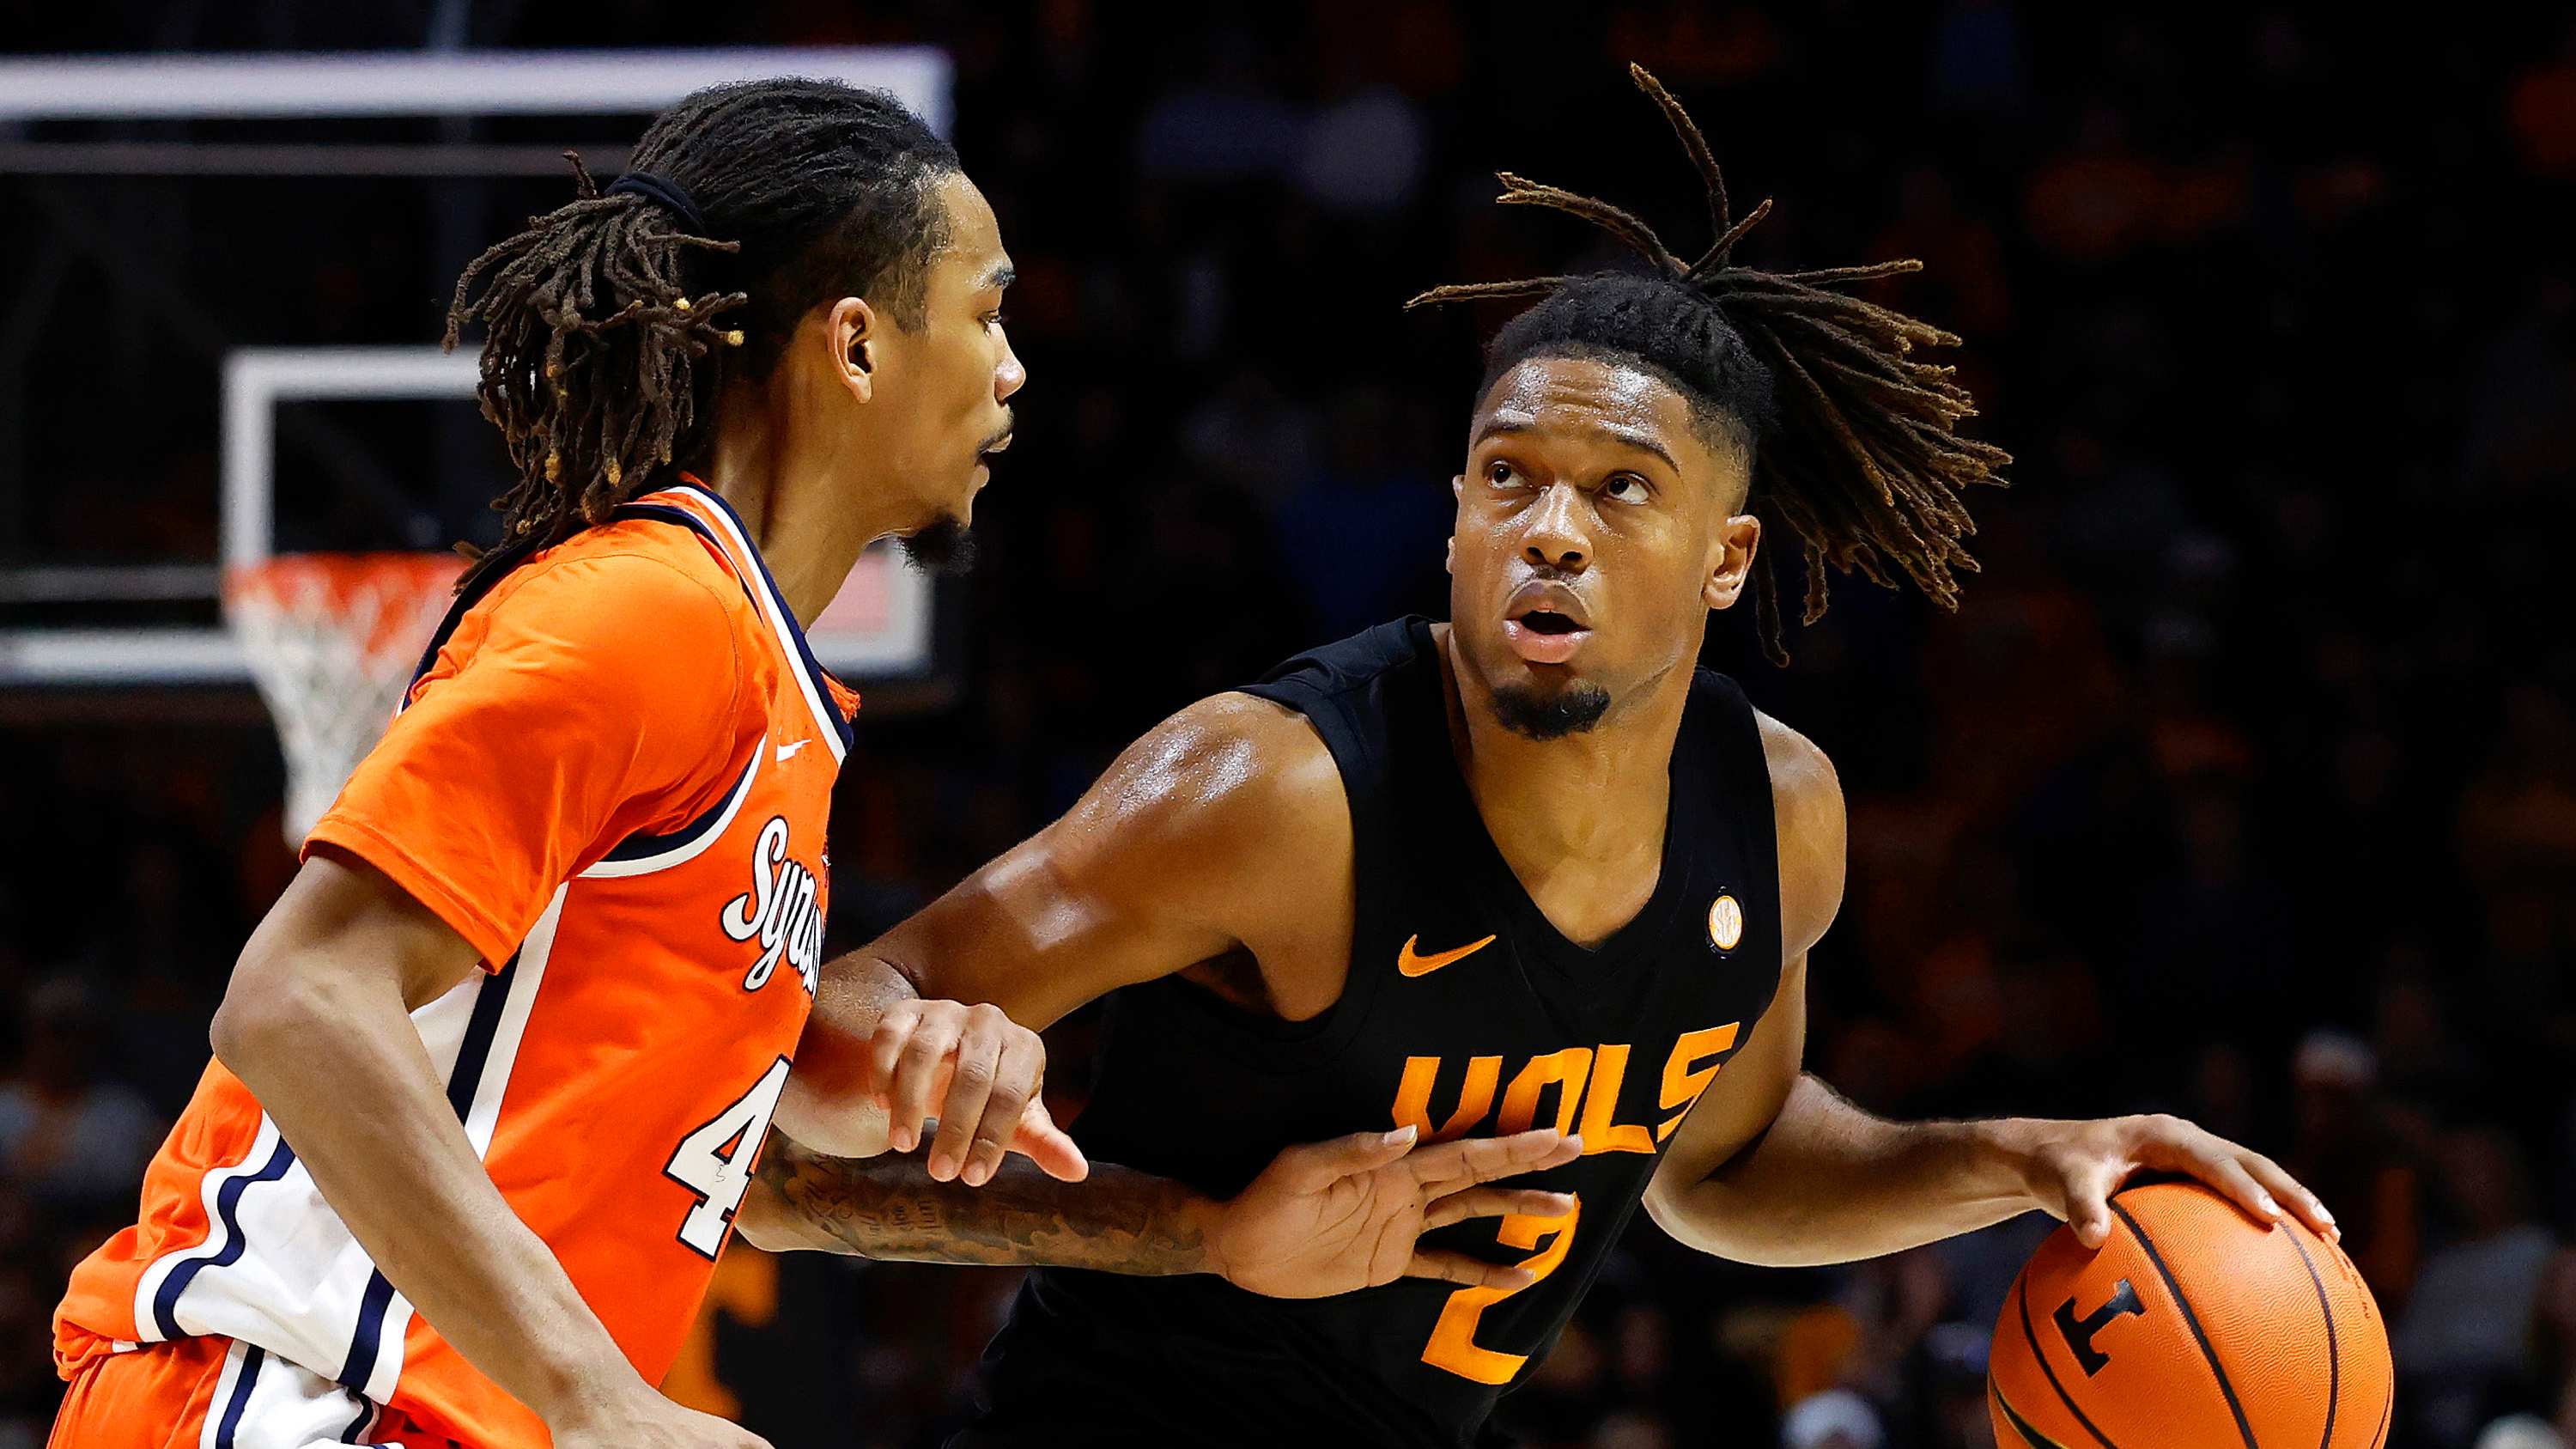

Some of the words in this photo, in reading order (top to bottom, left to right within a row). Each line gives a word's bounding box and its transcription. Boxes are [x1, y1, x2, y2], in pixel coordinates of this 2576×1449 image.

[662, 1054, 792, 1262] 4
[1391, 1021, 1741, 1155] VOLS
[1421, 1191, 1582, 1385] 2
[2052, 1277, 2146, 1379] T
